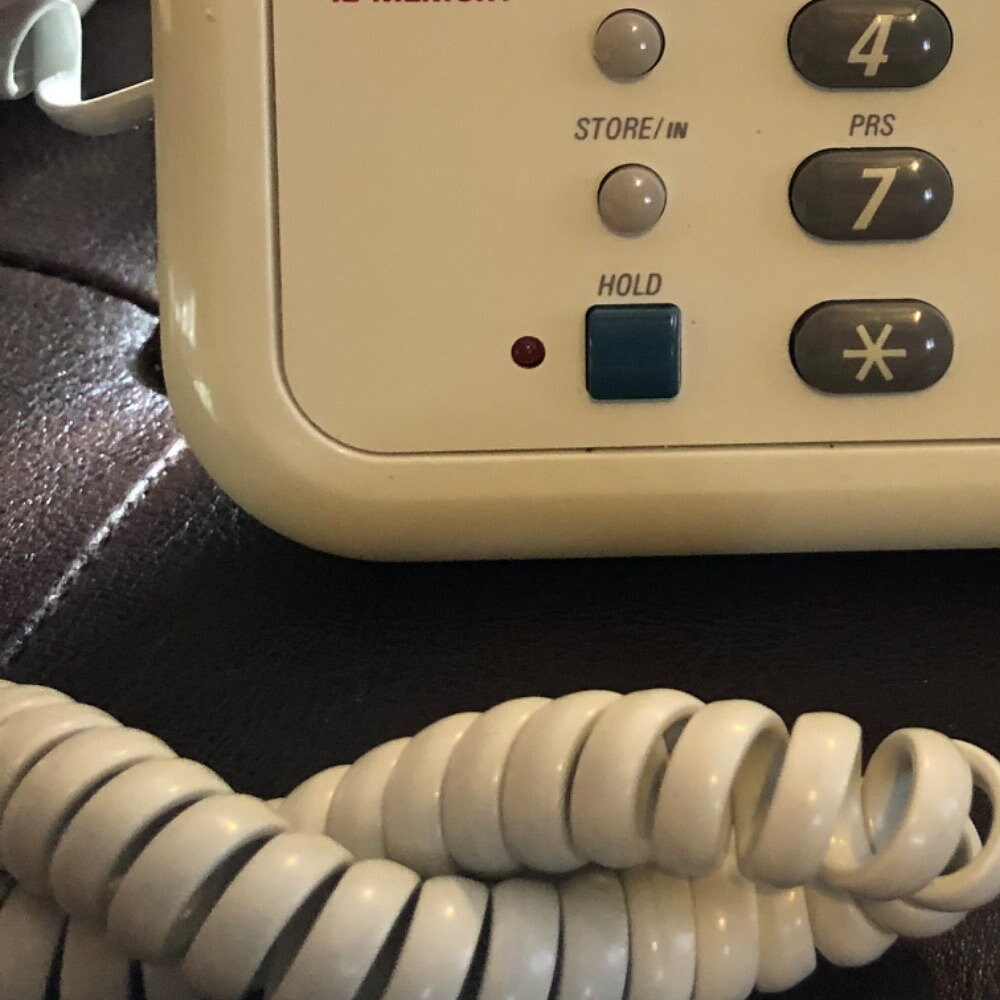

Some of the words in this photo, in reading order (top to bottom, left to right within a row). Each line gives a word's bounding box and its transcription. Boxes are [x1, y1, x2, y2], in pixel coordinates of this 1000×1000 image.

[847, 14, 893, 76] 4
[849, 114, 896, 136] PRS
[852, 167, 899, 230] 7
[598, 273, 662, 296] HOLD
